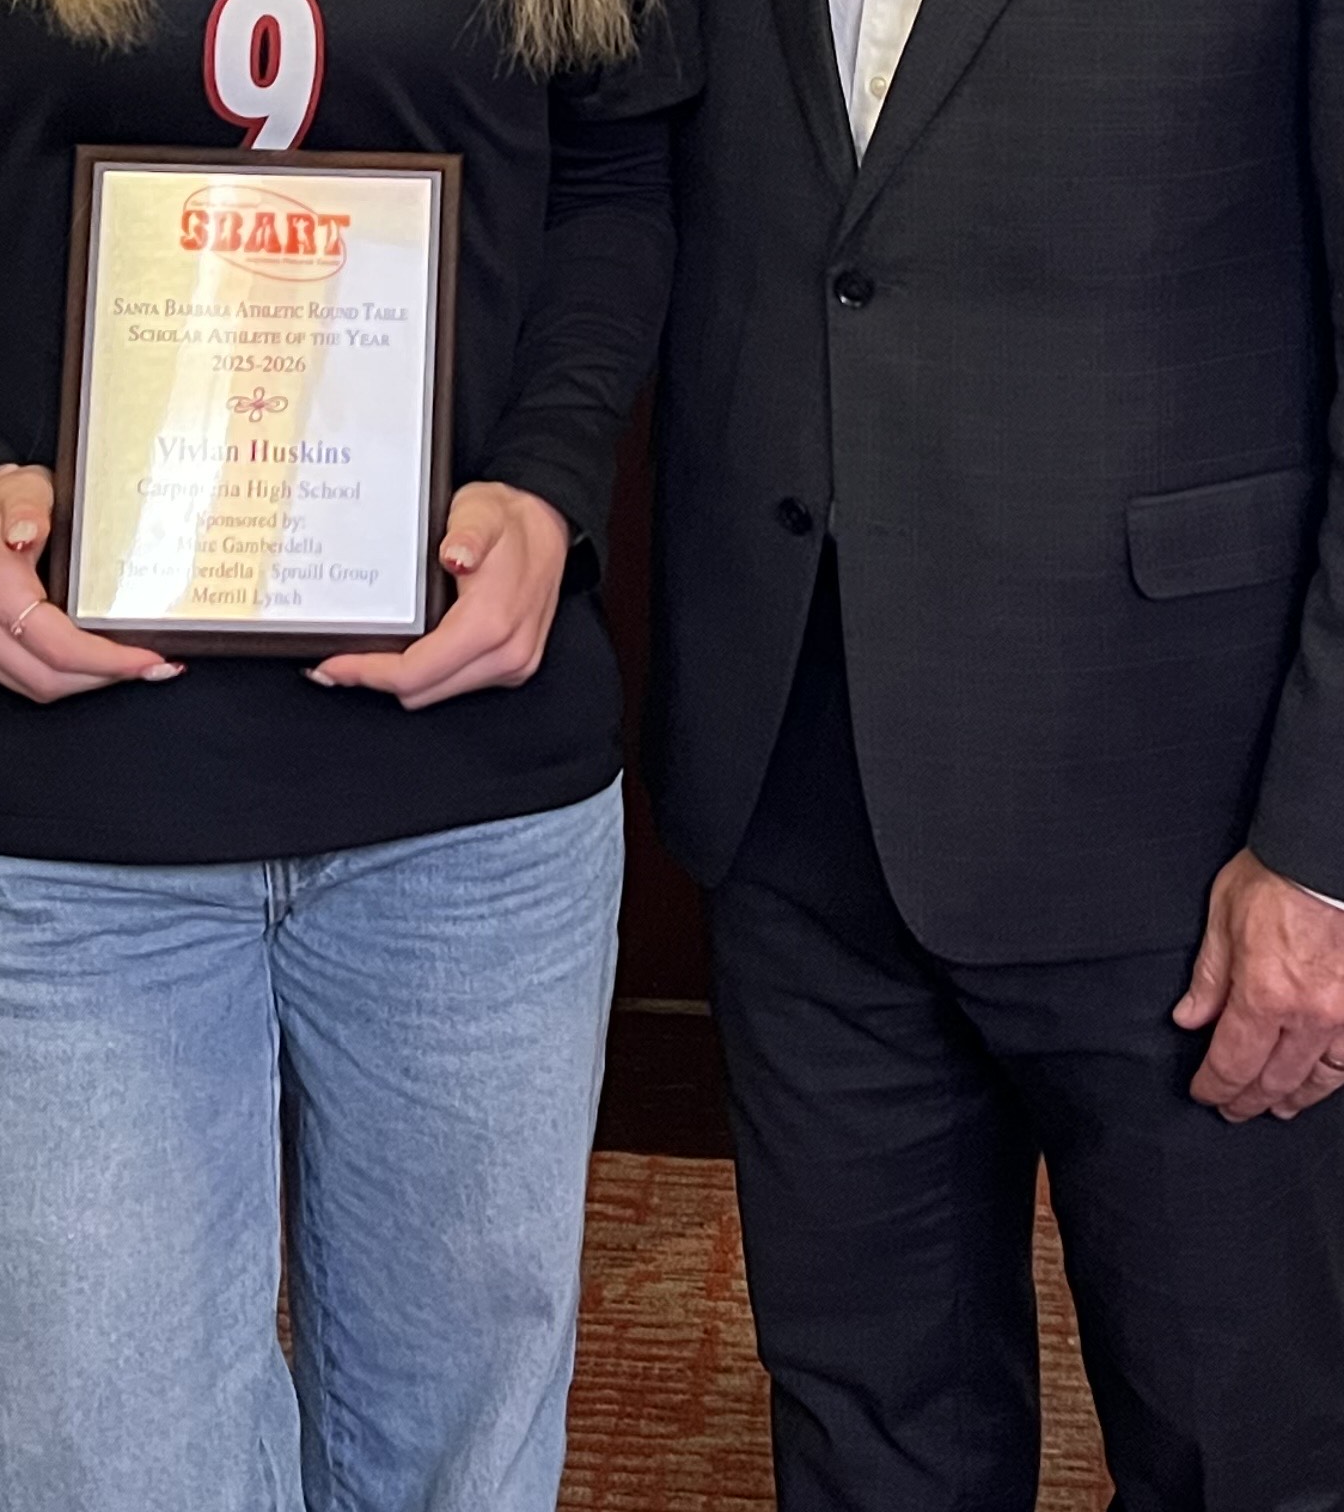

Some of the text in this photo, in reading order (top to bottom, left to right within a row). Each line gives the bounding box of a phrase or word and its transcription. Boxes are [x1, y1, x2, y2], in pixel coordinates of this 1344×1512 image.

[180, 210, 351, 256] SBART
[212, 354, 306, 373] 2025-2026
[250, 439, 351, 464] Huskins
[247, 480, 292, 503] High
[297, 481, 361, 500] School
[282, 512, 306, 534] by:
[222, 536, 323, 555] Gamberdella
[271, 563, 324, 582] Spruill
[328, 565, 379, 586] Group
[192, 587, 302, 608] Merrill Lynch
